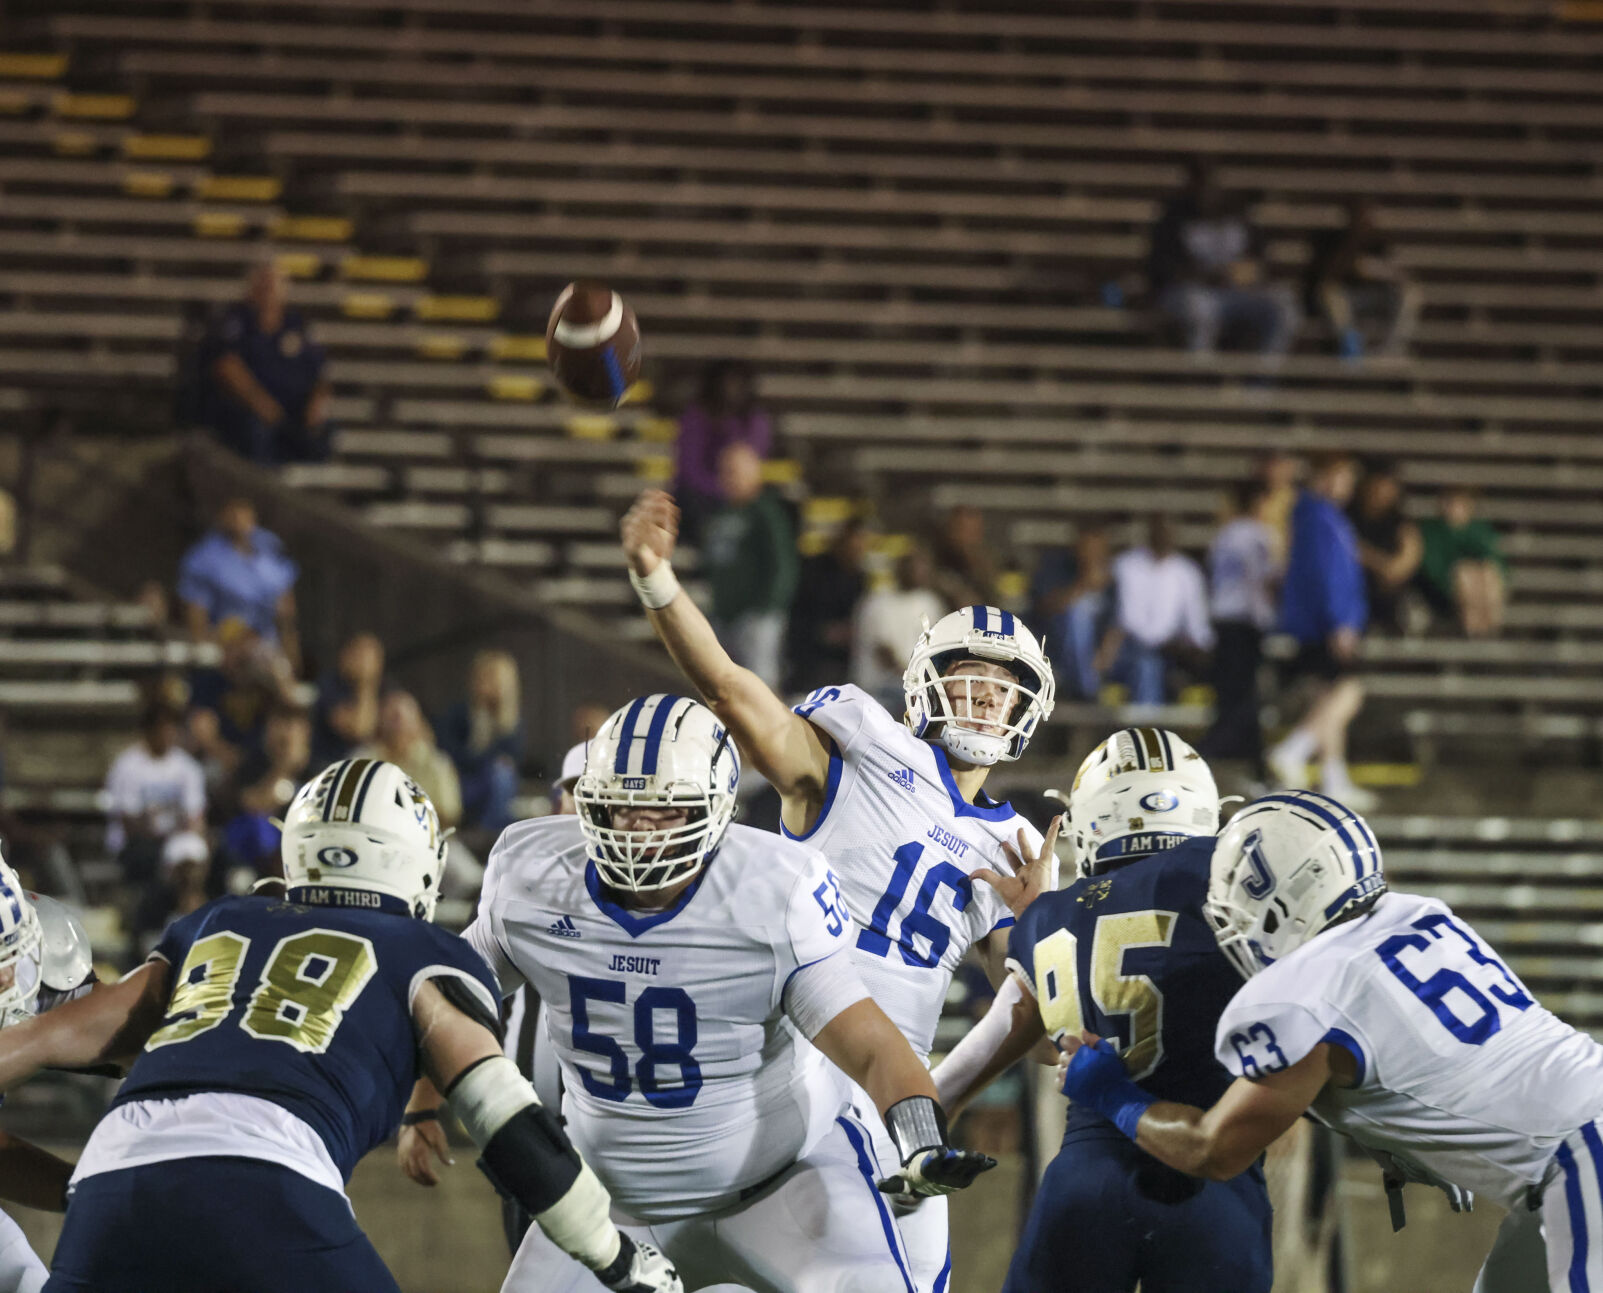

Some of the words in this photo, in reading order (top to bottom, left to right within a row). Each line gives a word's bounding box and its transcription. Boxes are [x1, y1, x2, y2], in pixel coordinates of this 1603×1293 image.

[623, 779, 646, 789] JAYS
[927, 824, 969, 858] JESUIT
[1121, 838, 1127, 853] I
[1130, 836, 1152, 851] AM
[301, 888, 306, 903] I
[309, 889, 329, 904] AM
[334, 890, 382, 908] THIRD
[856, 841, 973, 969] 16
[144, 928, 378, 1054] 98
[608, 955, 661, 976] JESUIT
[1375, 914, 1535, 1045] 63
[1033, 910, 1180, 1082] 95
[568, 974, 703, 1109] 58
[1230, 1021, 1289, 1080] 63
